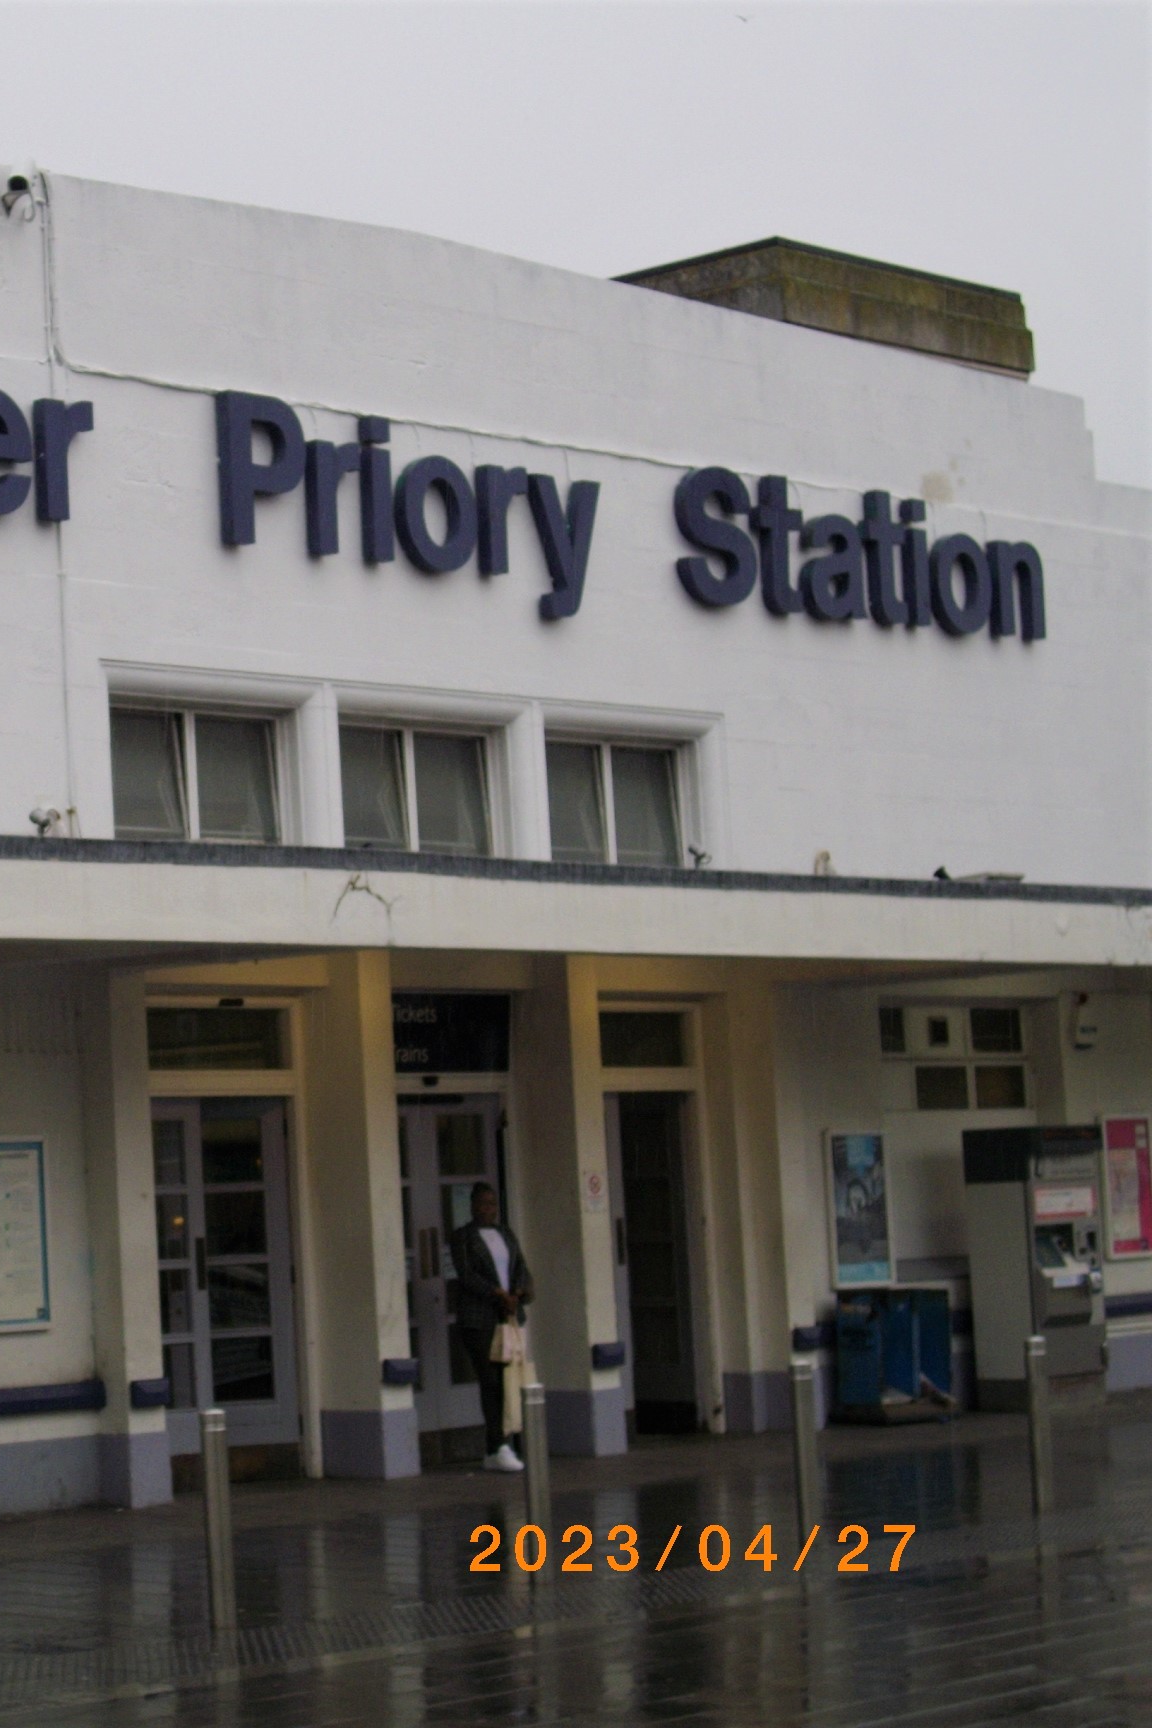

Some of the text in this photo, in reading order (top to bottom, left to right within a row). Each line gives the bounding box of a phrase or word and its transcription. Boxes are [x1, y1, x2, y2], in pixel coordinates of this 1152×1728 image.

[214, 389, 601, 621] Priory
[673, 466, 1047, 641] Station
[394, 1044, 430, 1063] rains
